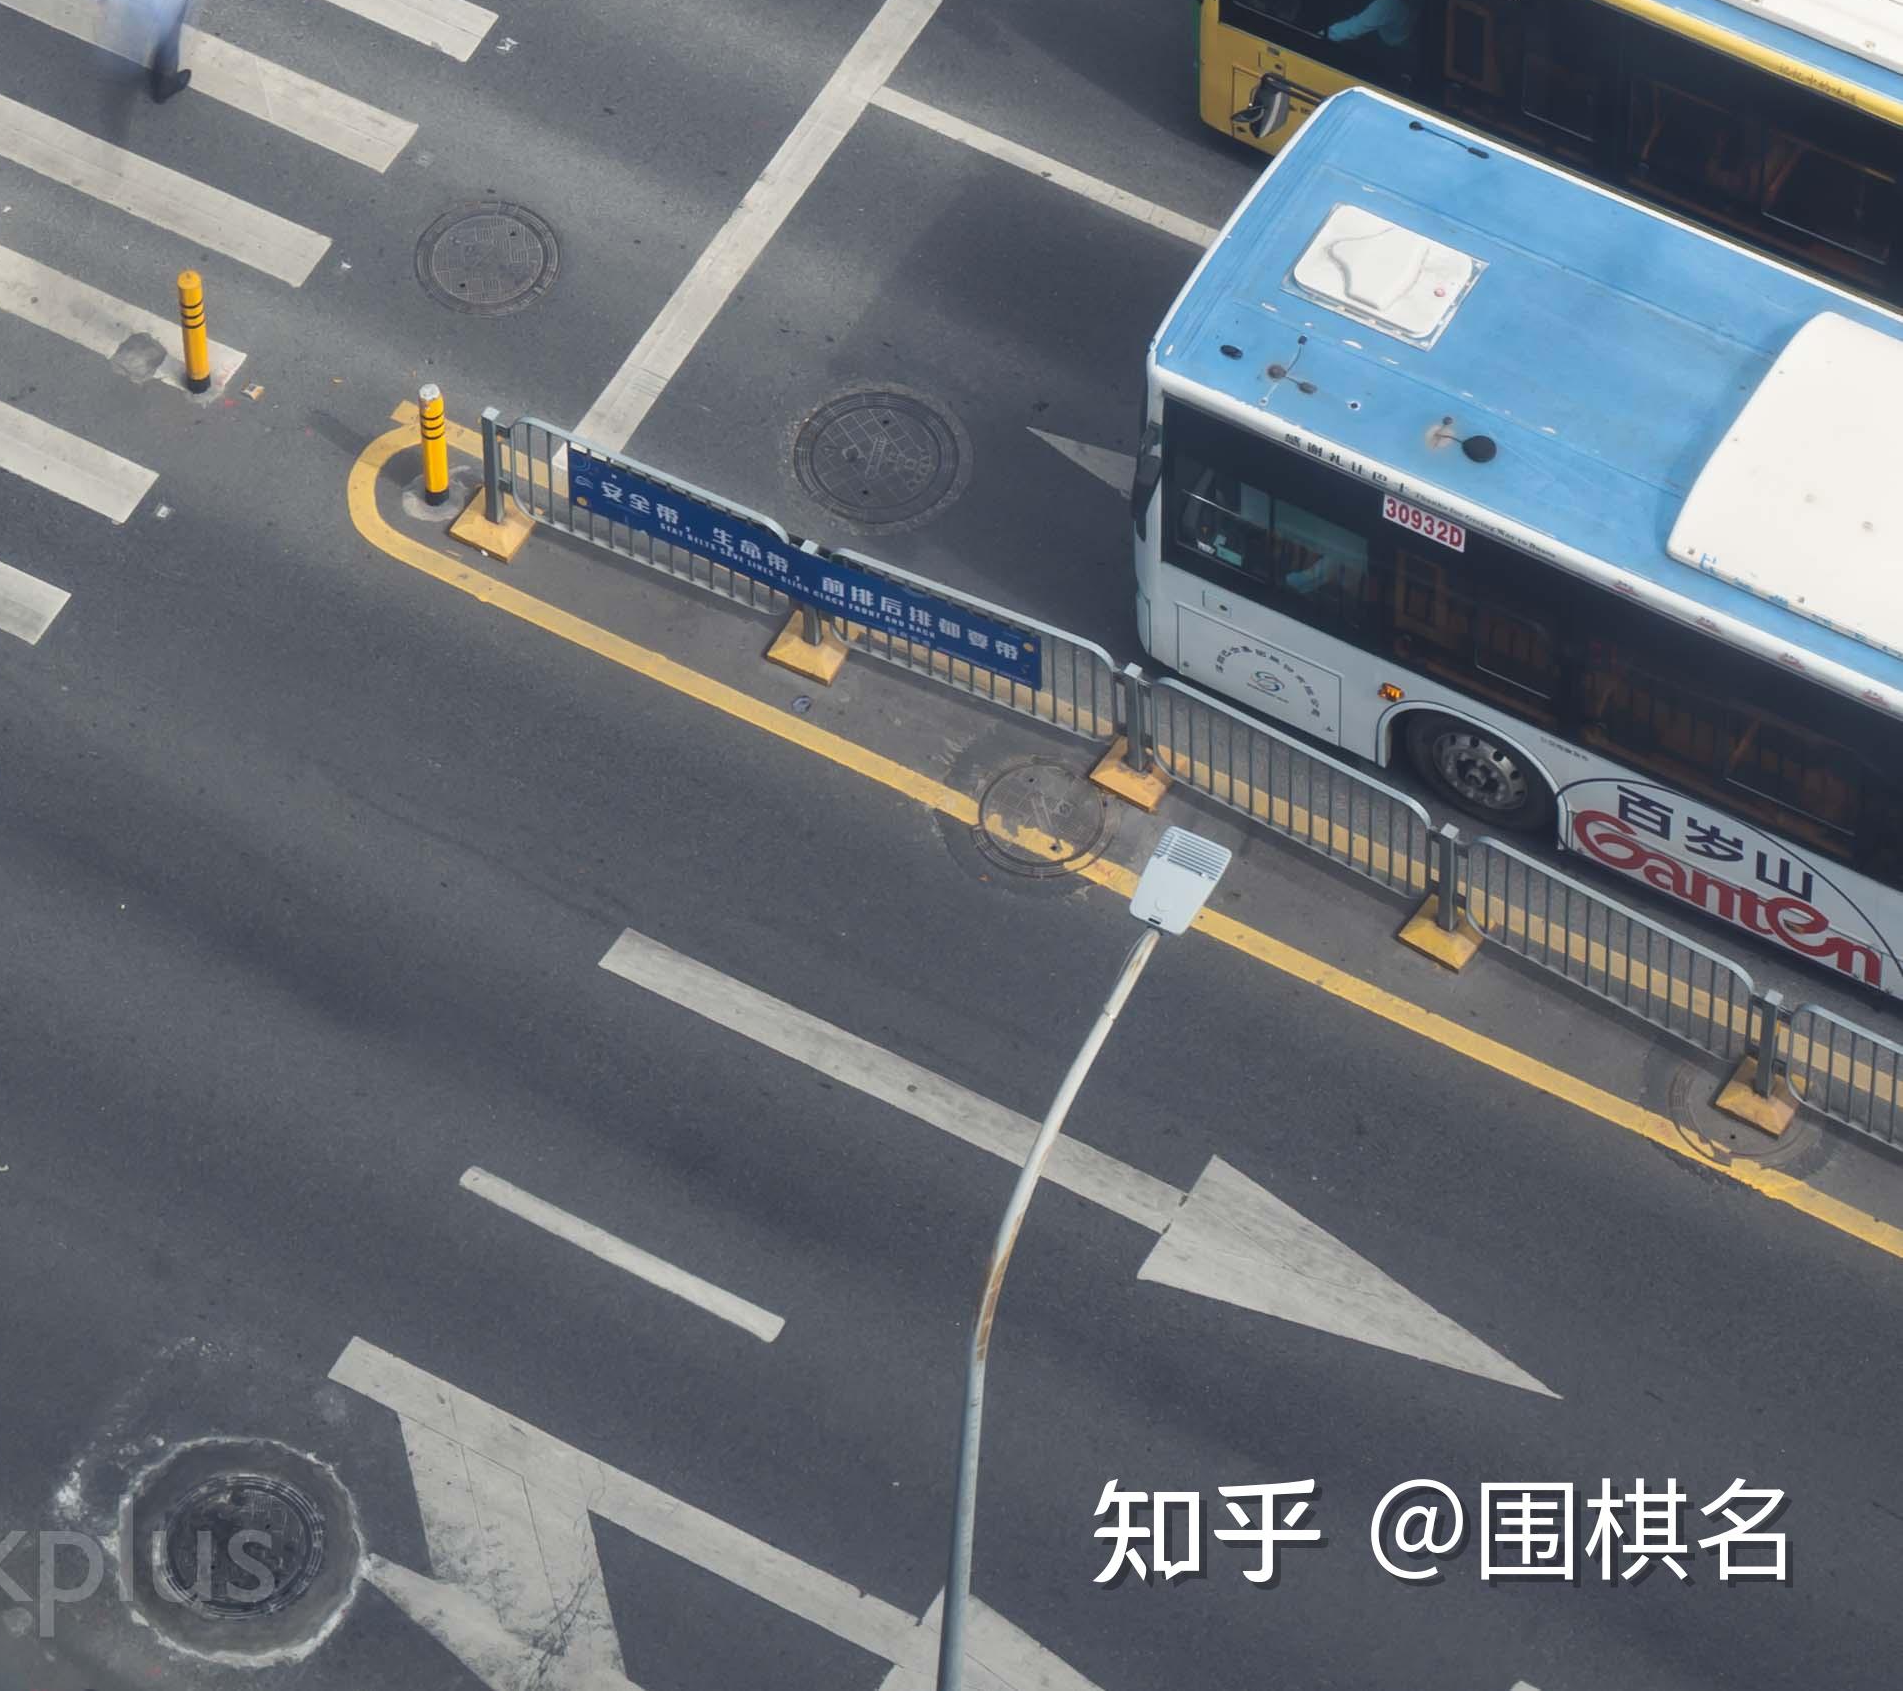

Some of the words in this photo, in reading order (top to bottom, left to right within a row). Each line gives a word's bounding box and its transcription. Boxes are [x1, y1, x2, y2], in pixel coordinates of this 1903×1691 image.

[1385, 498, 1463, 548] 30932D
[1574, 810, 1881, 985] Ganten
[1617, 784, 1813, 903] 百岁山
